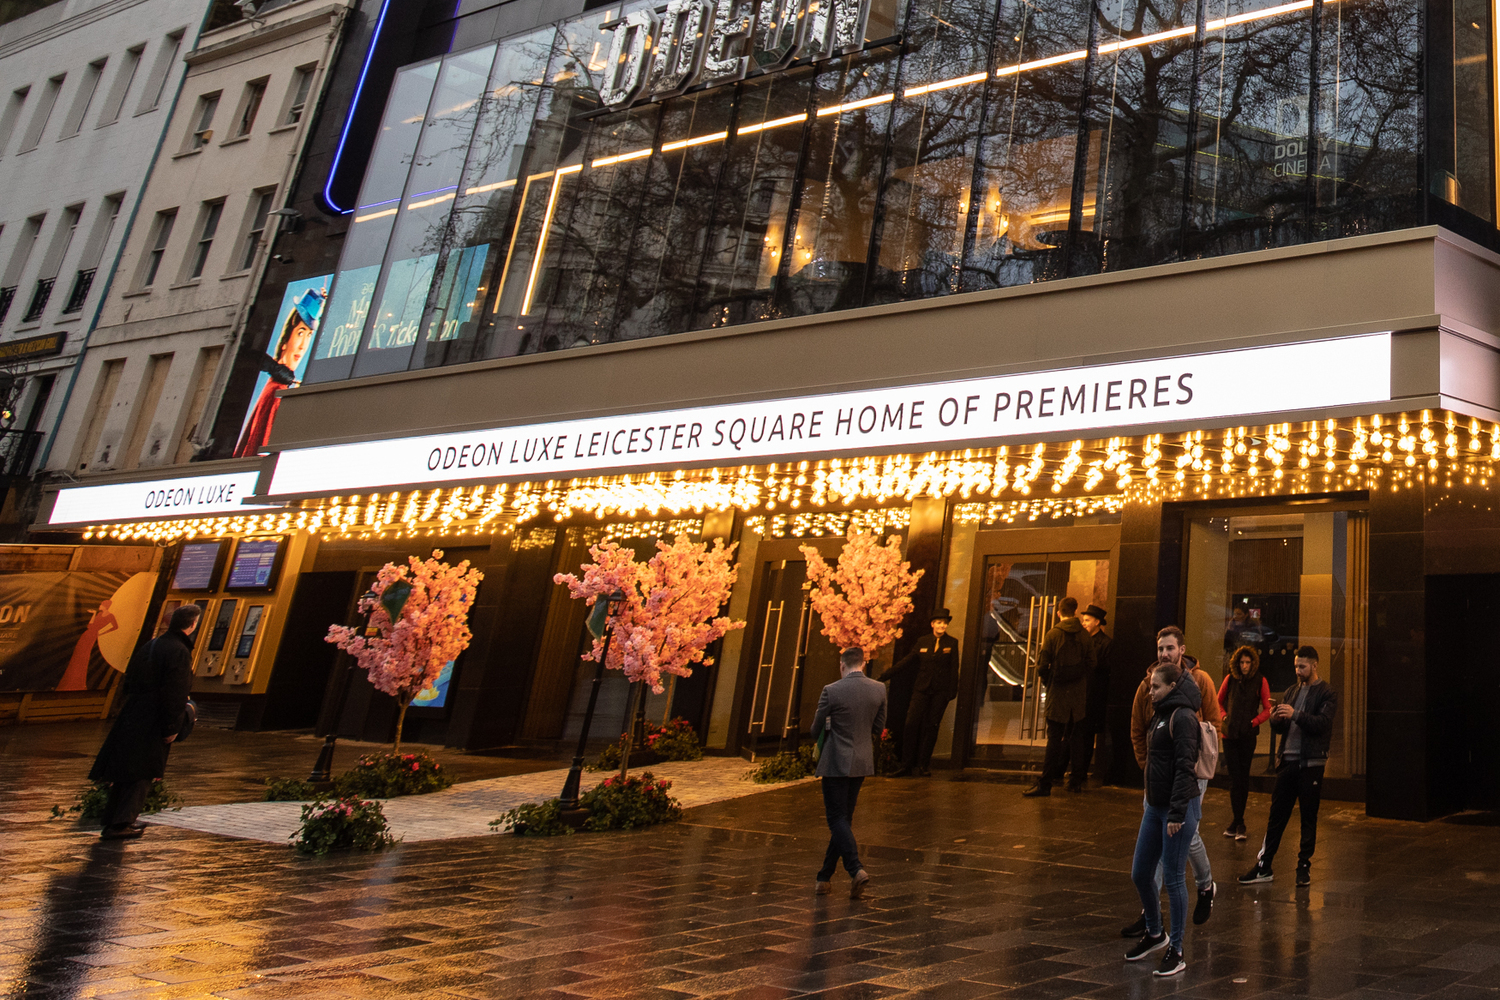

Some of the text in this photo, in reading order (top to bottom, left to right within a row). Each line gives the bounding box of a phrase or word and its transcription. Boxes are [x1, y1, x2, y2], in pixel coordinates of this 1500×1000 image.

[1274, 137, 1331, 160] DOLY
[1273, 155, 1332, 178] CINEA
[428, 372, 1194, 471] ODEON LUXE LEICESTER SQUARE HOME OF PREMIERES
[144, 484, 236, 509] ODEON LUXE
